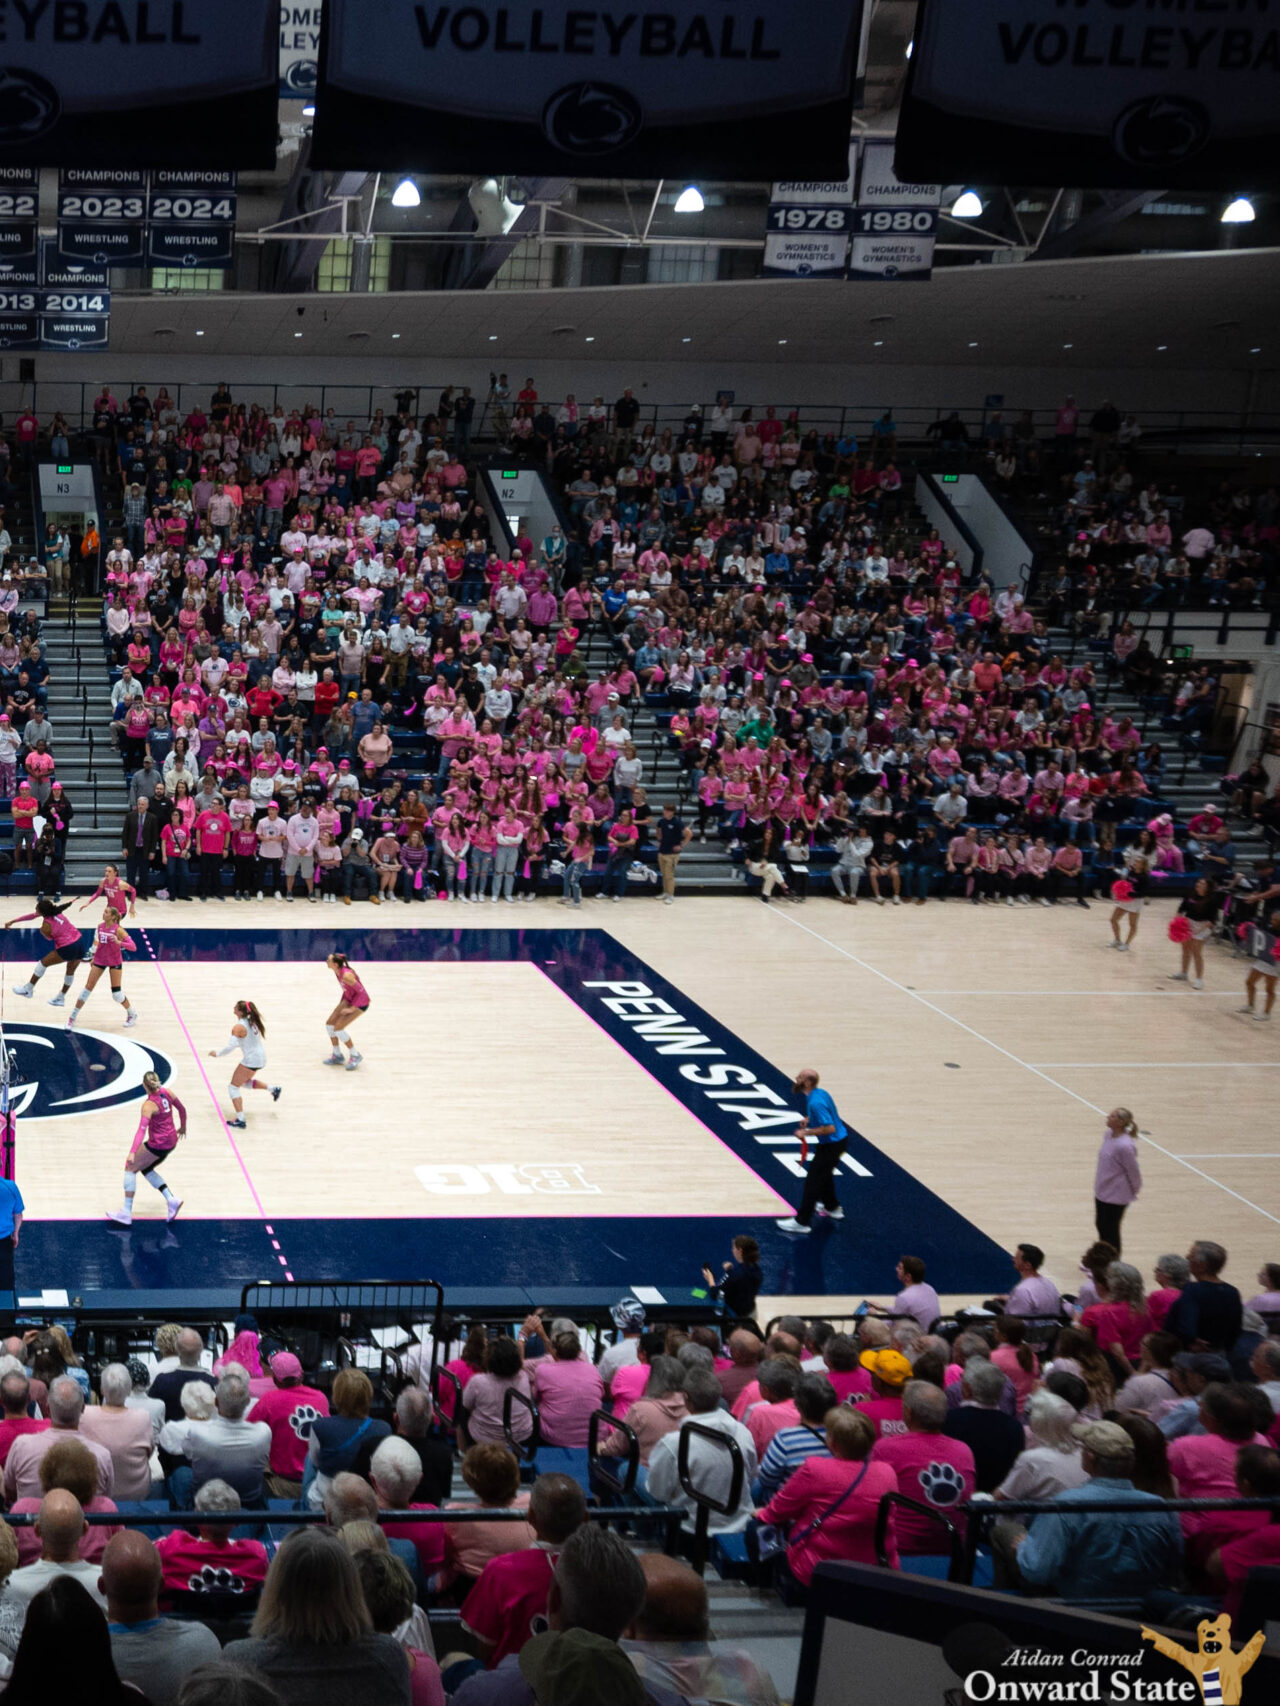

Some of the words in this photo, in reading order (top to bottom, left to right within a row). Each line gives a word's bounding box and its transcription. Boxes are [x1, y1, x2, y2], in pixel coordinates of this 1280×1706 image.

[414, 5, 781, 60] VOLLEYBALL
[67, 169, 140, 182] CHAMPIONS
[158, 170, 230, 182] CHAMPIONS
[778, 182, 849, 193] CHAMPIONS
[866, 185, 936, 196] CHAMPIONS
[62, 196, 143, 218] 2023
[152, 198, 233, 219] 2024
[773, 208, 846, 230] 1978
[860, 211, 933, 232] 1980
[74, 233, 129, 244] WRESTLING
[164, 235, 218, 246] WRESTLING
[785, 243, 829, 252] WOMEN'S
[871, 245, 915, 254] WOMEN'S
[776, 252, 835, 261] GYMNASTICS
[863, 255, 922, 263] GYMNASTICS
[48, 273, 105, 283] CHAMPIONS
[45, 295, 104, 311] 2014
[53, 324, 96, 332] WRESTLING
[57, 483, 70, 494] N3
[502, 489, 515, 499] N2
[582, 981, 727, 1055] PENN
[162, 1097, 171, 1112] 9
